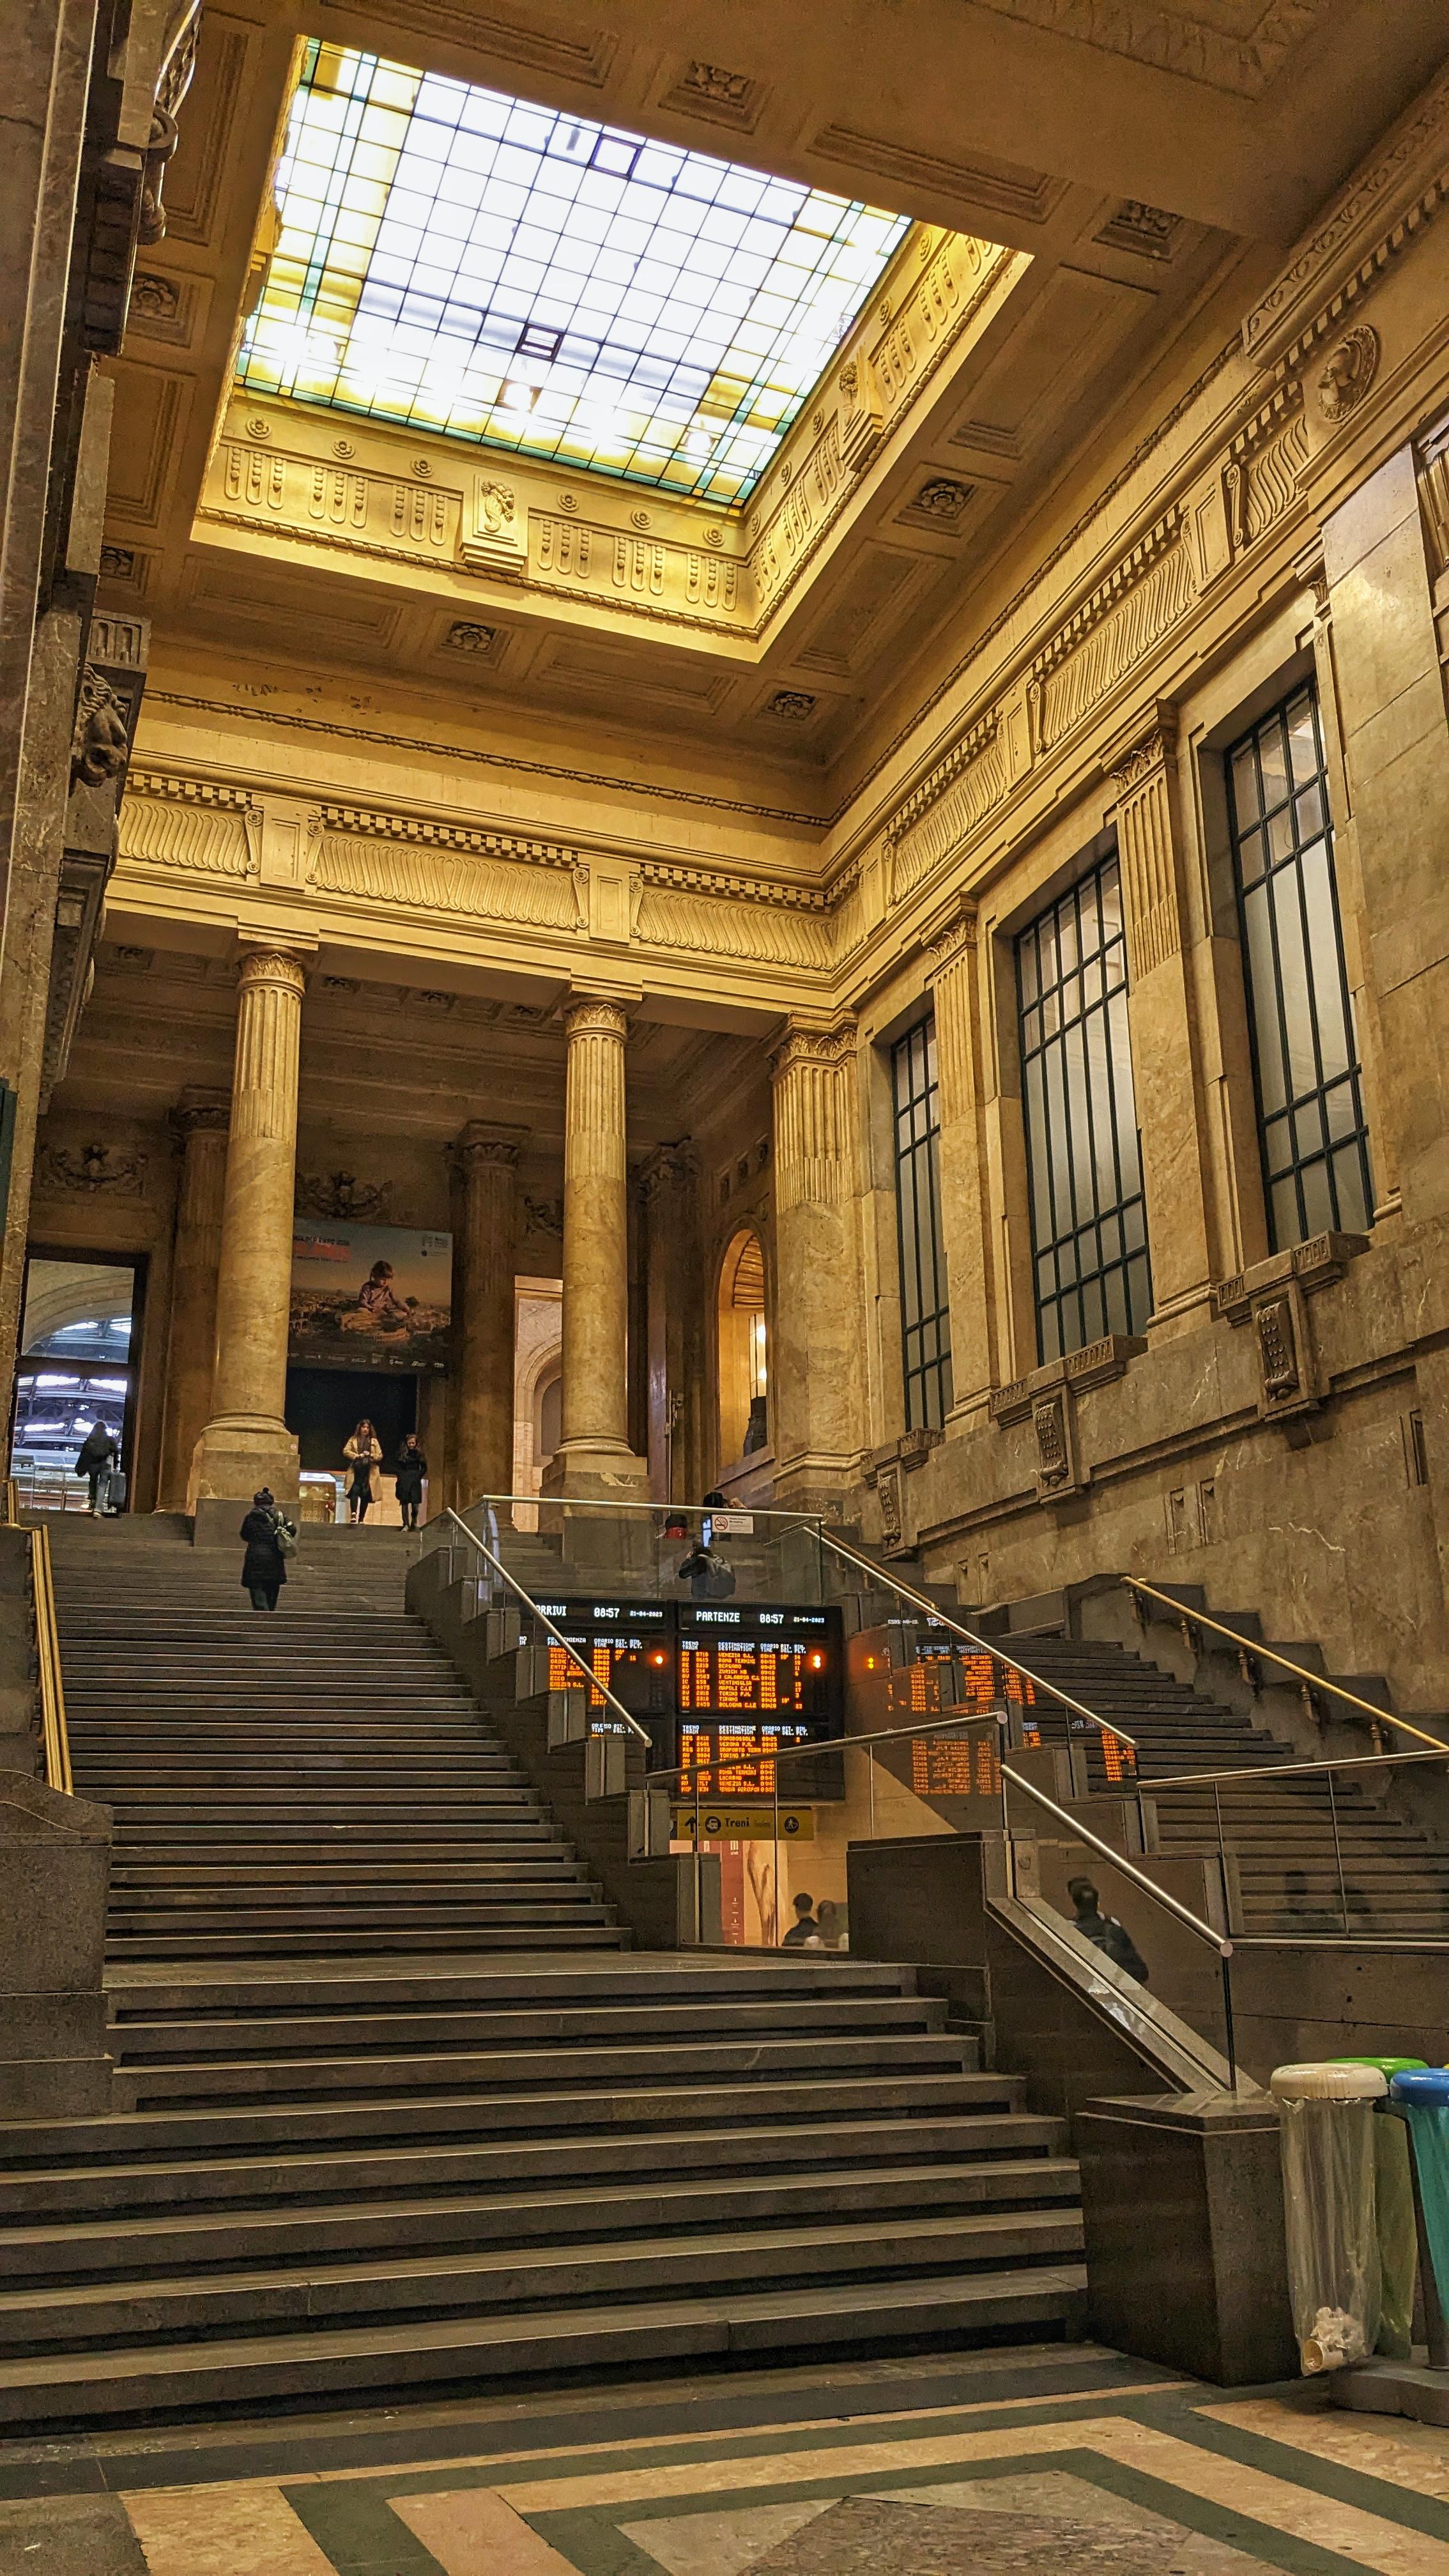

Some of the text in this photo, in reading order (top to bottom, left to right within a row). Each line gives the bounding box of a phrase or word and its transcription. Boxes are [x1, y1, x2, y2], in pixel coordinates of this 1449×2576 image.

[594, 1607, 620, 1618] 08:57
[696, 1611, 740, 1623] PARTENZE
[760, 1614, 784, 1624] 08:57
[724, 1818, 749, 1827] Treni
